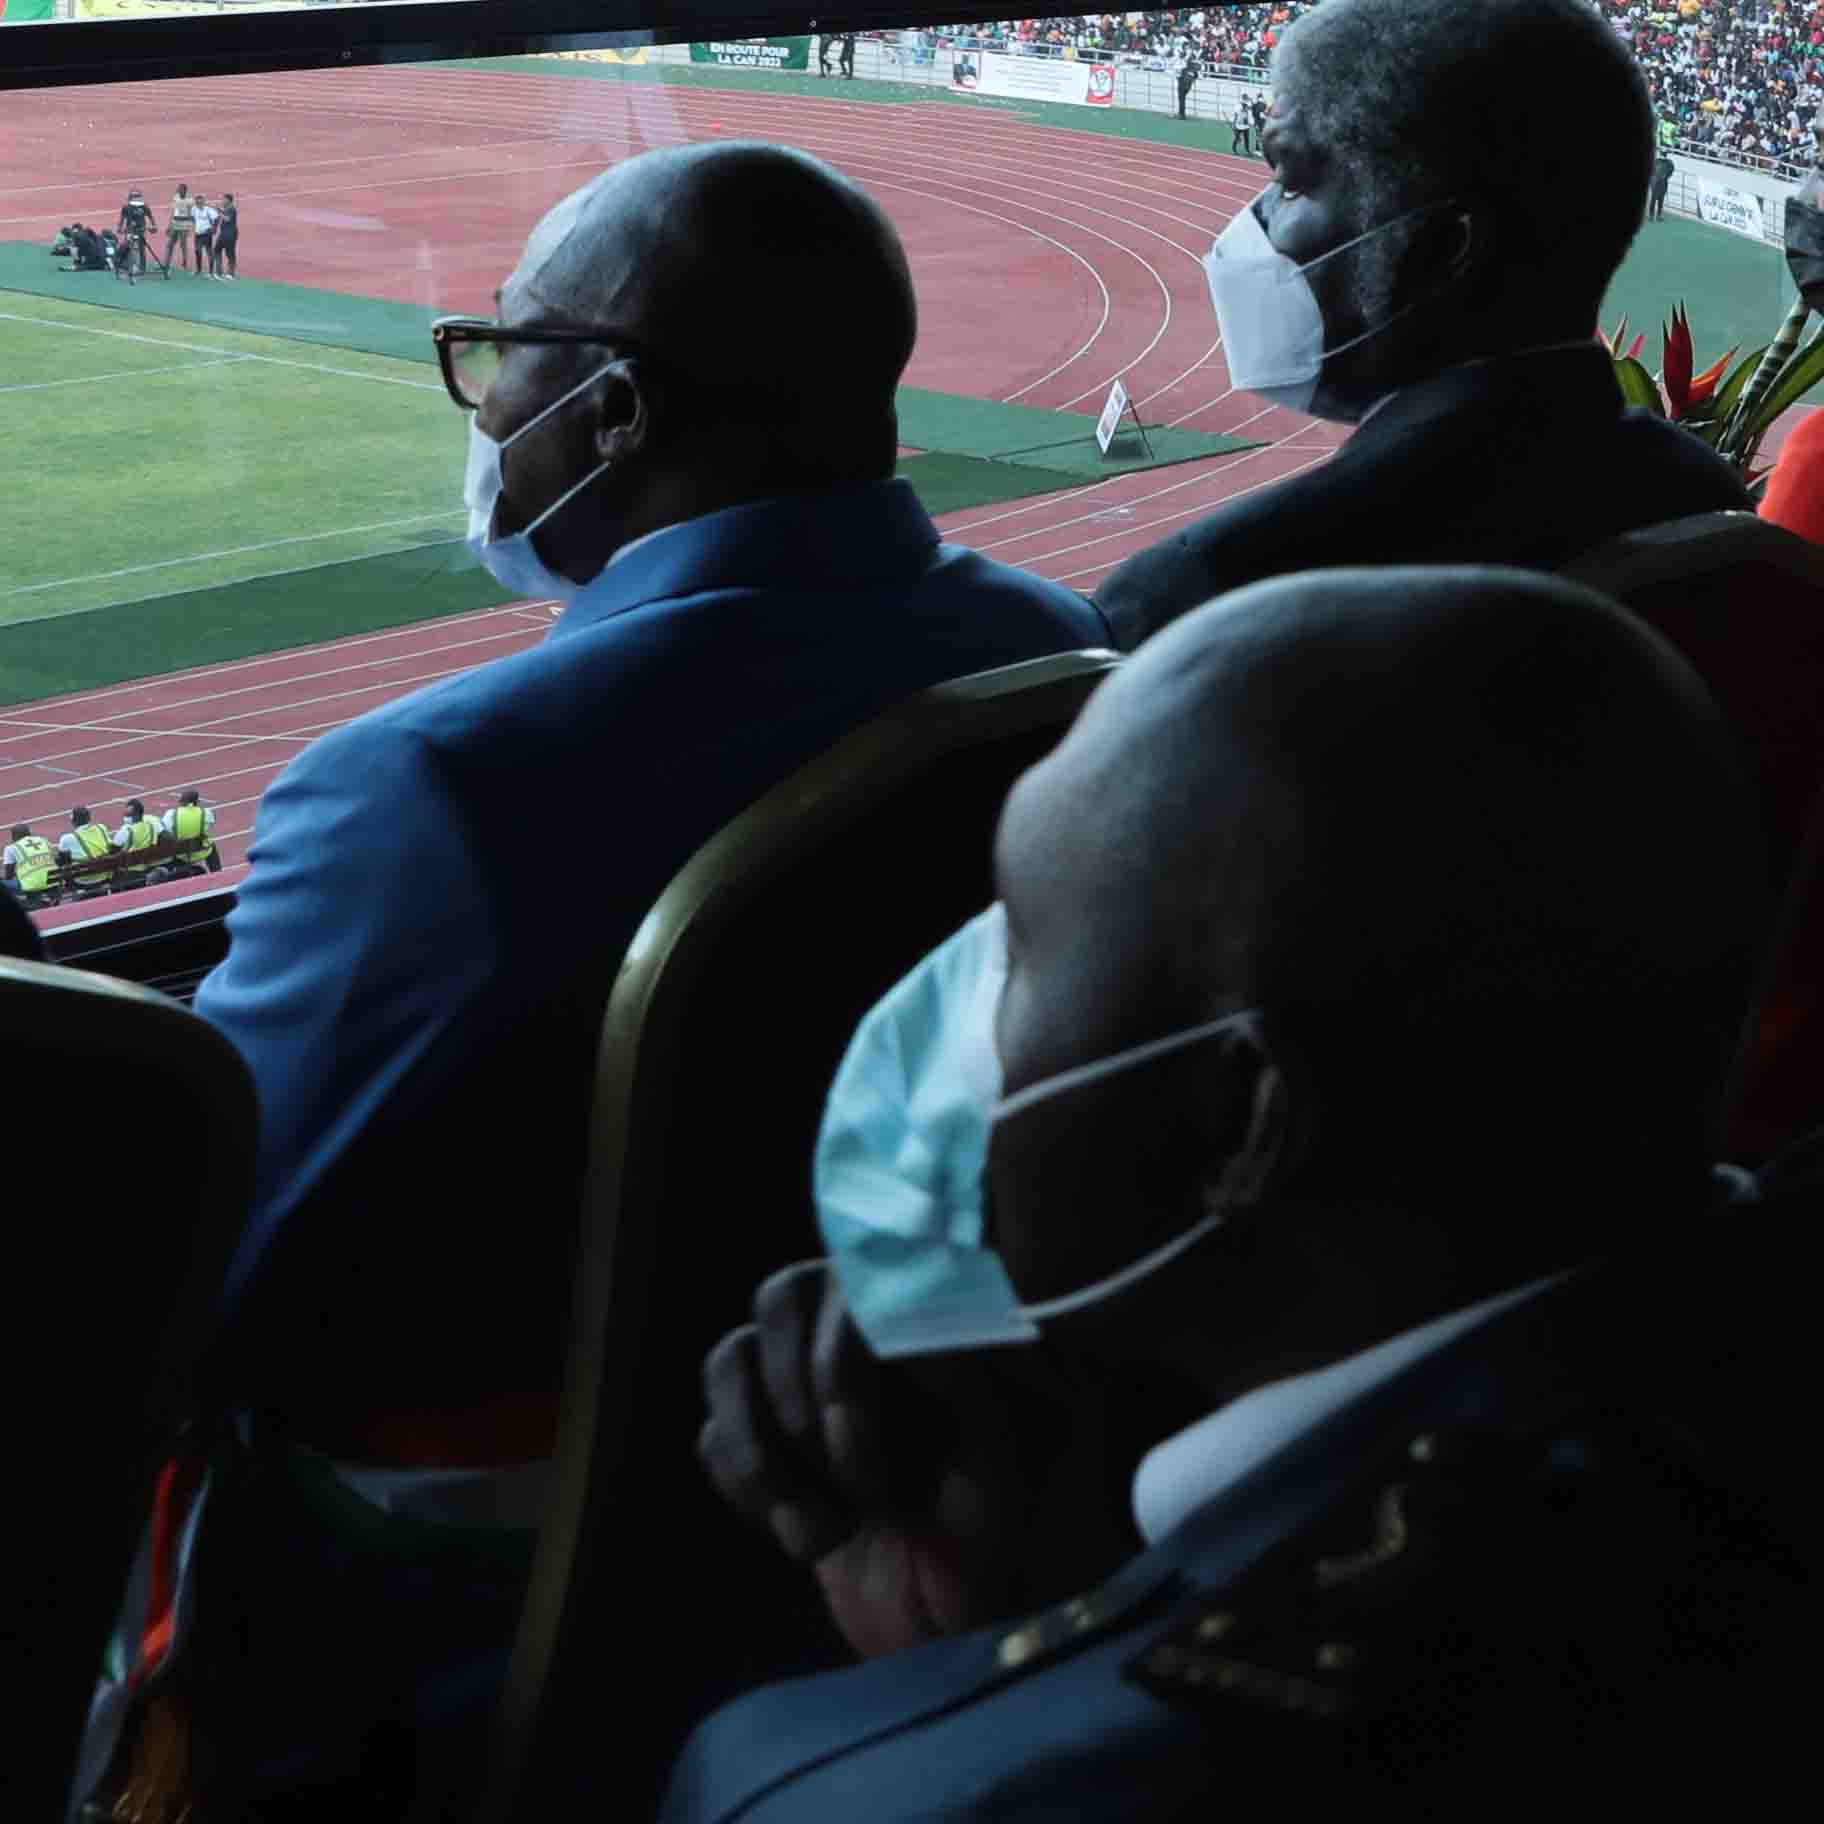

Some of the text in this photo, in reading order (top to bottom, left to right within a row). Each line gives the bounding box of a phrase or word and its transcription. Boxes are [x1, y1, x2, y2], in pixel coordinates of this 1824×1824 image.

[710, 42, 789, 57] EN ROUTE POUR
[719, 54, 731, 63] LA
[733, 55, 757, 65] CAN
